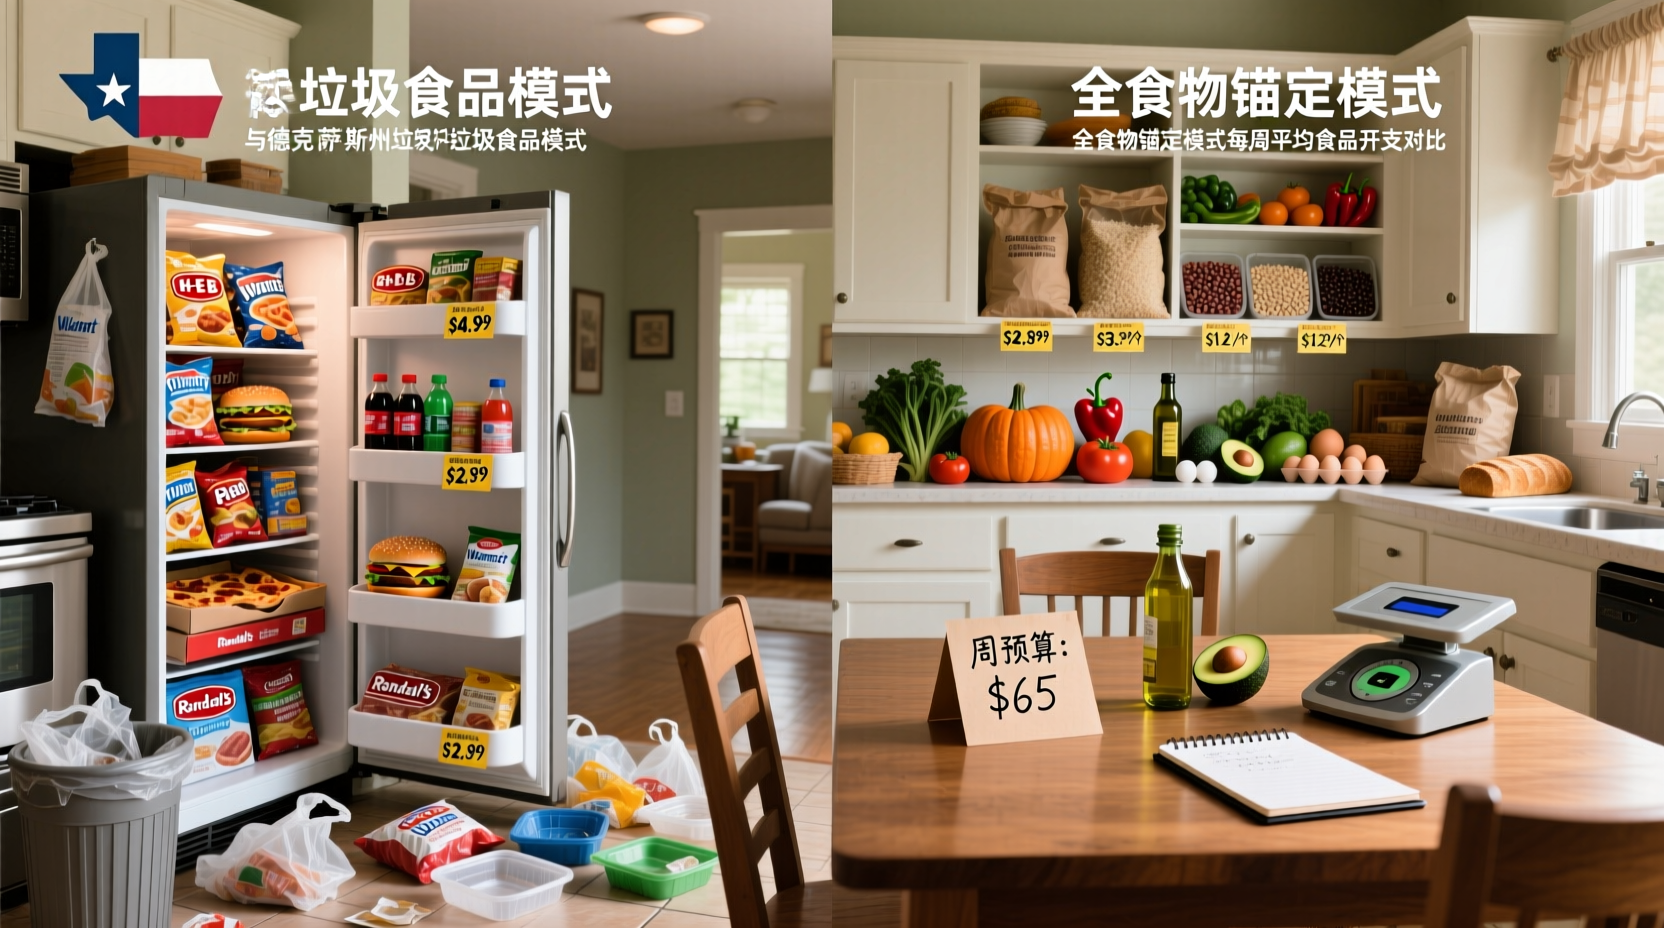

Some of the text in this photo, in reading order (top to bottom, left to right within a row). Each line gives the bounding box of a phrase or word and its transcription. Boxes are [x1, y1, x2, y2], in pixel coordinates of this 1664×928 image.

[448, 314, 492, 335] $4.99
[988, 674, 1057, 720] $65
[442, 742, 486, 761] $2.99
